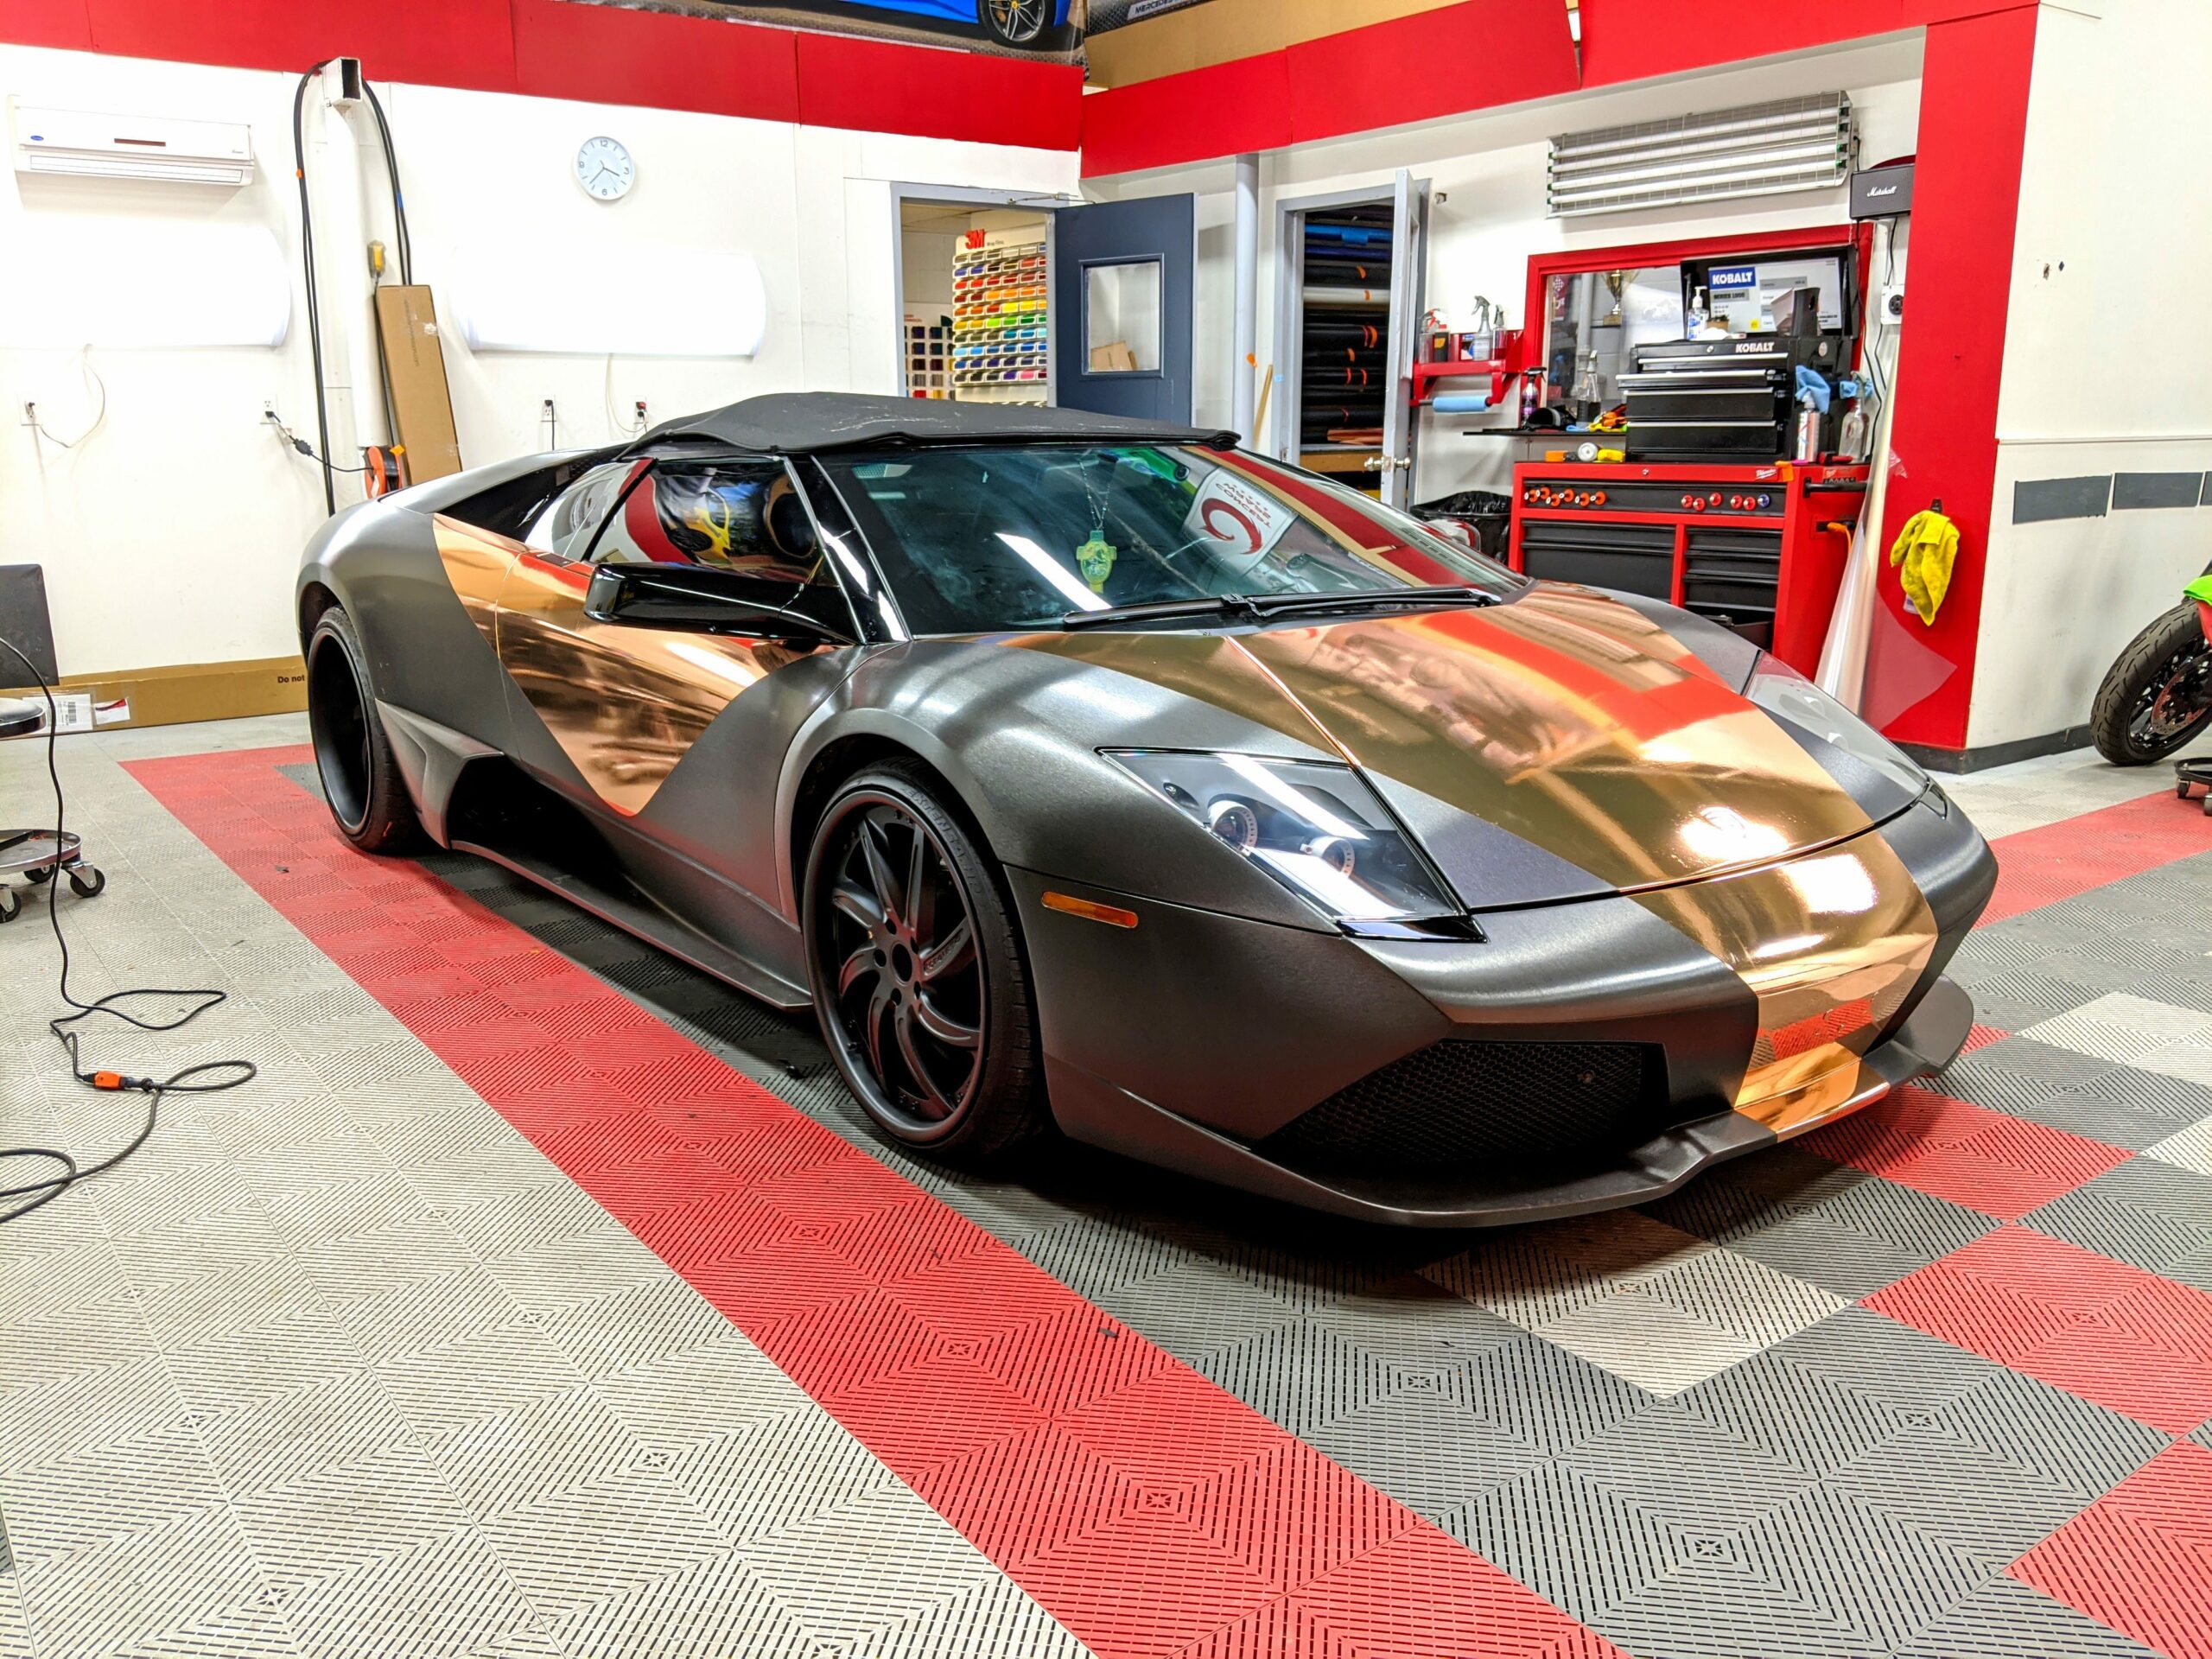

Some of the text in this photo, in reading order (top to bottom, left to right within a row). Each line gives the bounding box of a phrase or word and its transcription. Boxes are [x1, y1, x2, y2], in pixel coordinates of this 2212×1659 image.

[1866, 186, 1897, 197] Marshall
[965, 228, 985, 250] 3M
[1712, 271, 1752, 285] KOBALT
[1735, 342, 1775, 353] KOBALT
